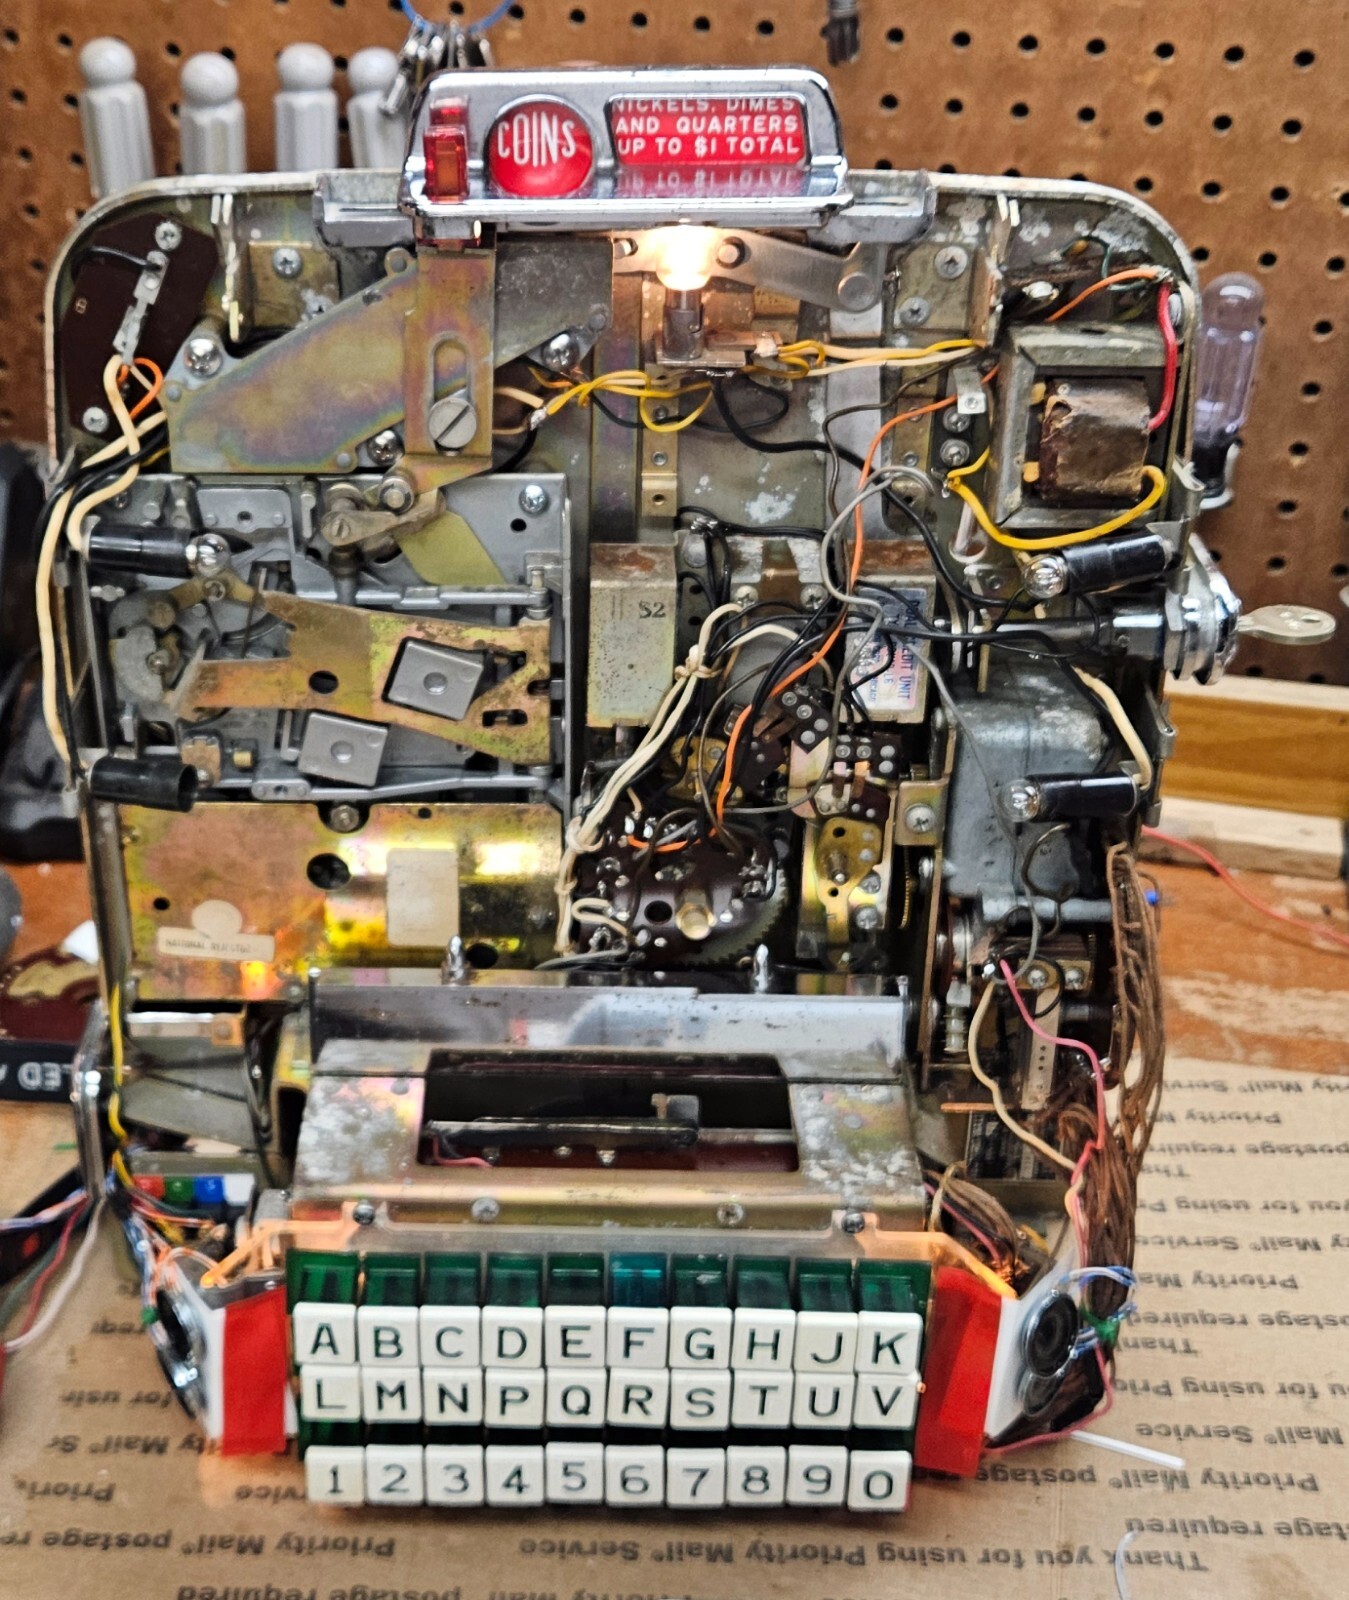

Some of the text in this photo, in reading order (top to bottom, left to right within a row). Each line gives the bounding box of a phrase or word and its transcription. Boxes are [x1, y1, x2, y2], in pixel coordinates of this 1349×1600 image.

[726, 99, 794, 113] DIMES
[615, 115, 799, 135] AND QUARTERS
[498, 111, 577, 168] COINS
[617, 135, 800, 158] UP TO $1 TOTAL
[638, 602, 666, 619] S2
[898, 675, 912, 700] UNIT
[1185, 1109, 1282, 1124] Priority
[1174, 1196, 1250, 1213] using
[1260, 1199, 1301, 1214] for
[1192, 1269, 1299, 1289] Priority
[1258, 1310, 1349, 1329] ostage
[311, 1325, 907, 1365] A B C D E F G H J K
[1181, 1376, 1265, 1397] using
[1277, 1381, 1320, 1399] for
[316, 1381, 900, 1417] L M N P Q R S T U V
[1135, 1422, 1253, 1443] Service
[327, 1463, 893, 1499] 1 2 3 4 5 6 7 8 9 0
[976, 1464, 1097, 1485] postage
[1200, 1466, 1319, 1492] Priority
[42, 1530, 172, 1550] postage
[276, 1534, 395, 1557] Priority
[519, 1537, 641, 1562] Service
[745, 1538, 866, 1566] Priority
[877, 1541, 966, 1565] using
[978, 1547, 1025, 1569] for
[1037, 1545, 1094, 1566] you
